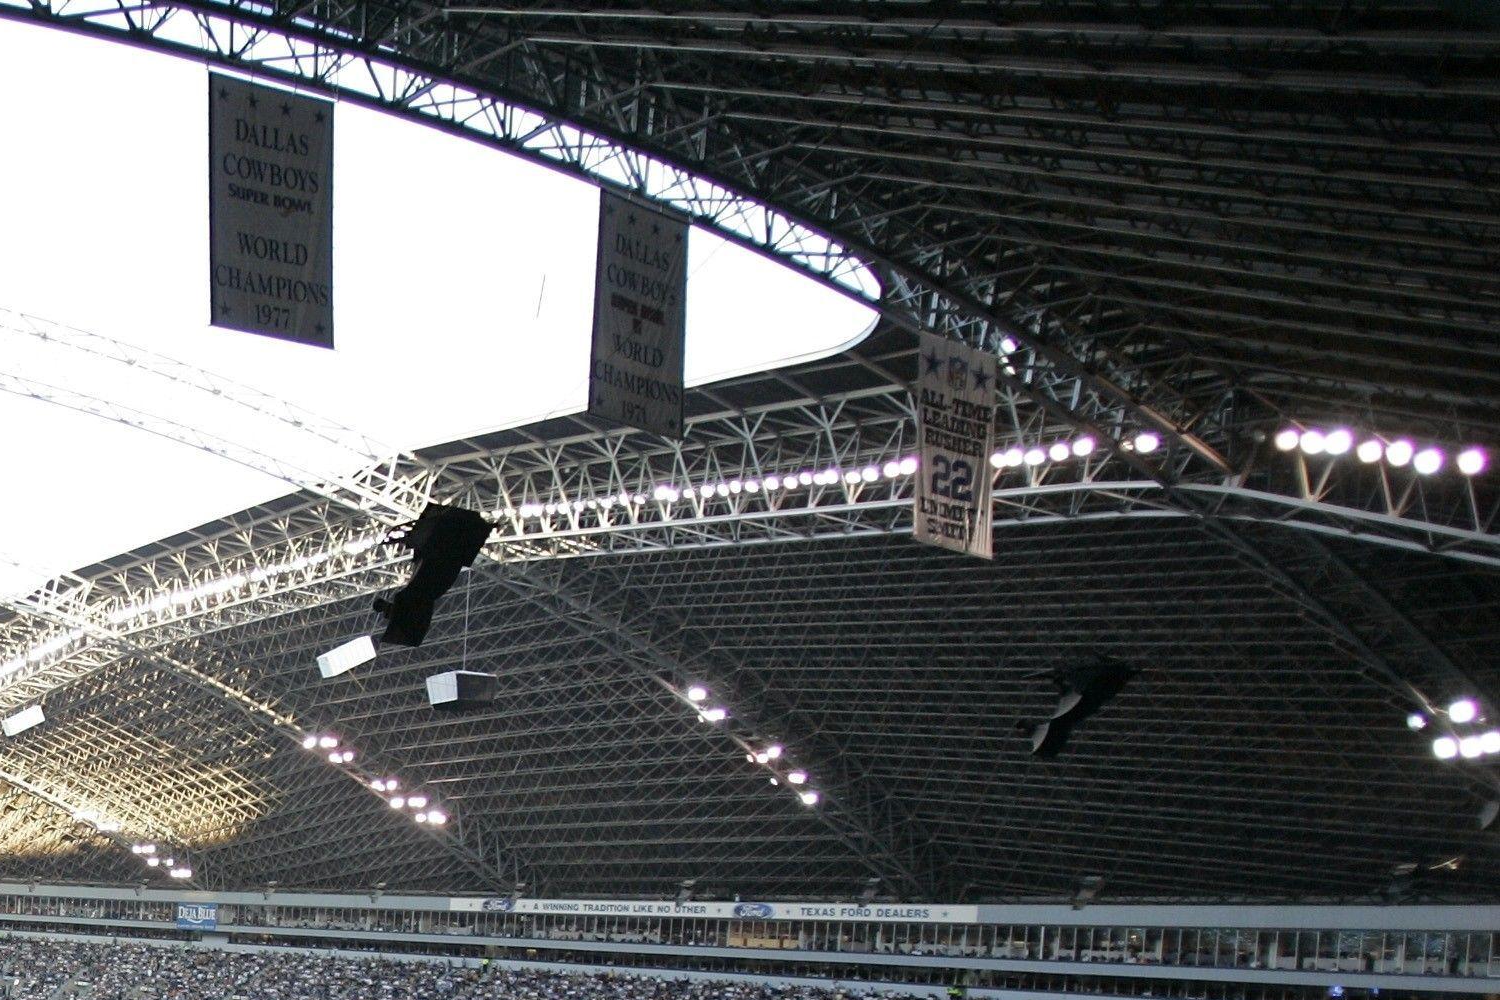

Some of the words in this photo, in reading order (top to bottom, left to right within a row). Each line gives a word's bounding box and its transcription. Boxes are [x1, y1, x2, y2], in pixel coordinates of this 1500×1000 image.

[235, 117, 310, 156] DALLAS
[223, 152, 319, 194] COWBOYS
[228, 183, 269, 205] SUPER
[237, 231, 308, 267] WORLD
[615, 233, 670, 272] DALLAS
[214, 263, 329, 306] CHAMPIONS
[607, 262, 676, 306] COWBOYS
[255, 303, 290, 329] 1977
[613, 332, 664, 369] WORLD
[594, 359, 680, 402] CHAMPIONS
[931, 454, 973, 502] 22
[542, 903, 579, 912] WINNING
[583, 904, 629, 913] TRADITION
[633, 905, 653, 913] LIKE
[657, 905, 670, 914] NO
[674, 905, 707, 914] OTHER
[740, 905, 764, 917] Ford
[800, 907, 835, 917] TEXAS
[840, 908, 871, 918] FORD
[876, 909, 929, 919] DEALERS
